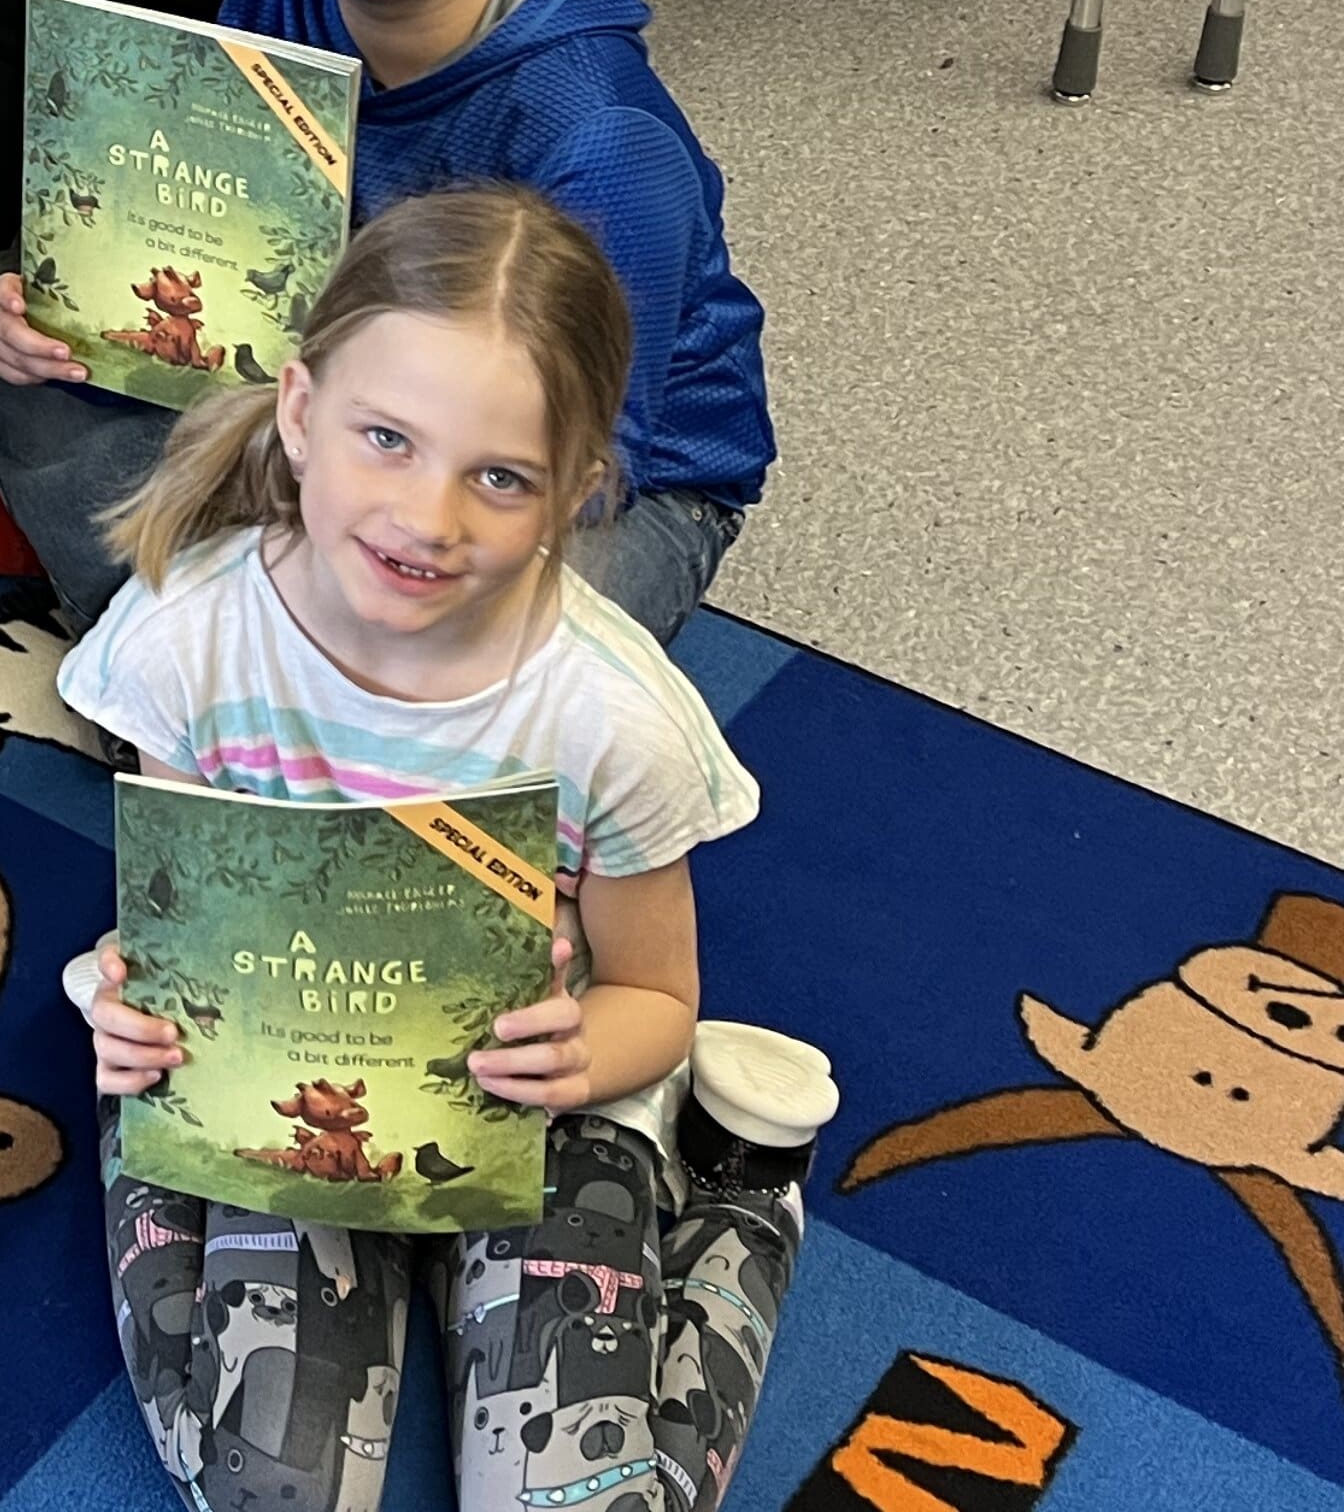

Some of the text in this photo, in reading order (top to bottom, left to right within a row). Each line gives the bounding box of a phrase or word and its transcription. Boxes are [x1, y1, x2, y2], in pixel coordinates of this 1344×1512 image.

[250, 63, 337, 167] SPECIAL EDITION
[149, 128, 170, 153] A
[107, 143, 251, 201] STRANGE
[148, 218, 185, 236] good
[187, 228, 203, 241] to
[205, 231, 224, 247] be
[145, 238, 239, 271] a bit different
[428, 817, 543, 903] SPECIAL EDITION
[289, 930, 317, 954] A
[232, 950, 428, 985] STRANGE
[290, 1029, 340, 1044] good
[346, 1032, 365, 1046] to
[369, 1031, 394, 1046] be
[287, 1049, 416, 1069] a bit different
